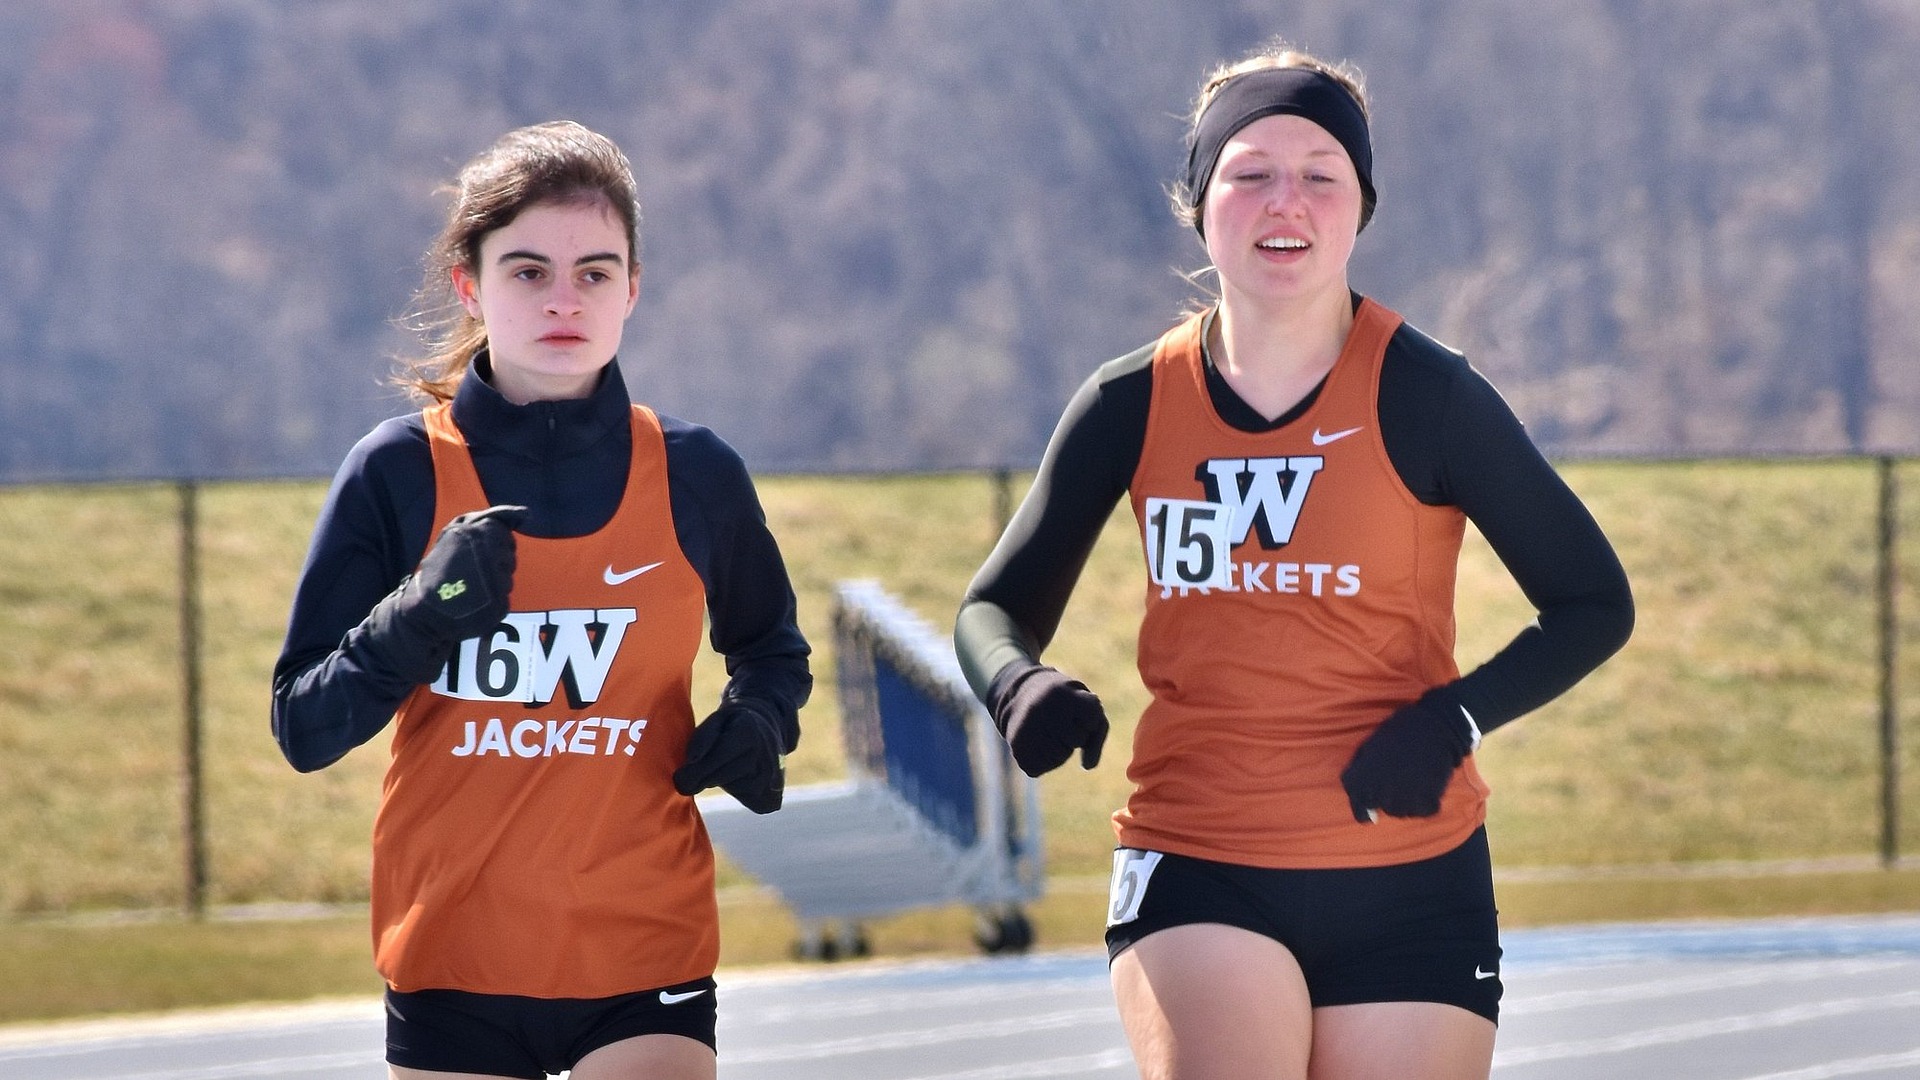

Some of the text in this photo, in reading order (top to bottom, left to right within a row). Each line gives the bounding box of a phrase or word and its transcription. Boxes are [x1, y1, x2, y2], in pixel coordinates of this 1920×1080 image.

[1195, 455, 1324, 551] W
[1150, 504, 1217, 583] 15
[1160, 562, 1361, 600] KETS
[446, 622, 521, 698] 16
[506, 607, 637, 709] W
[451, 716, 648, 758] JACKETS
